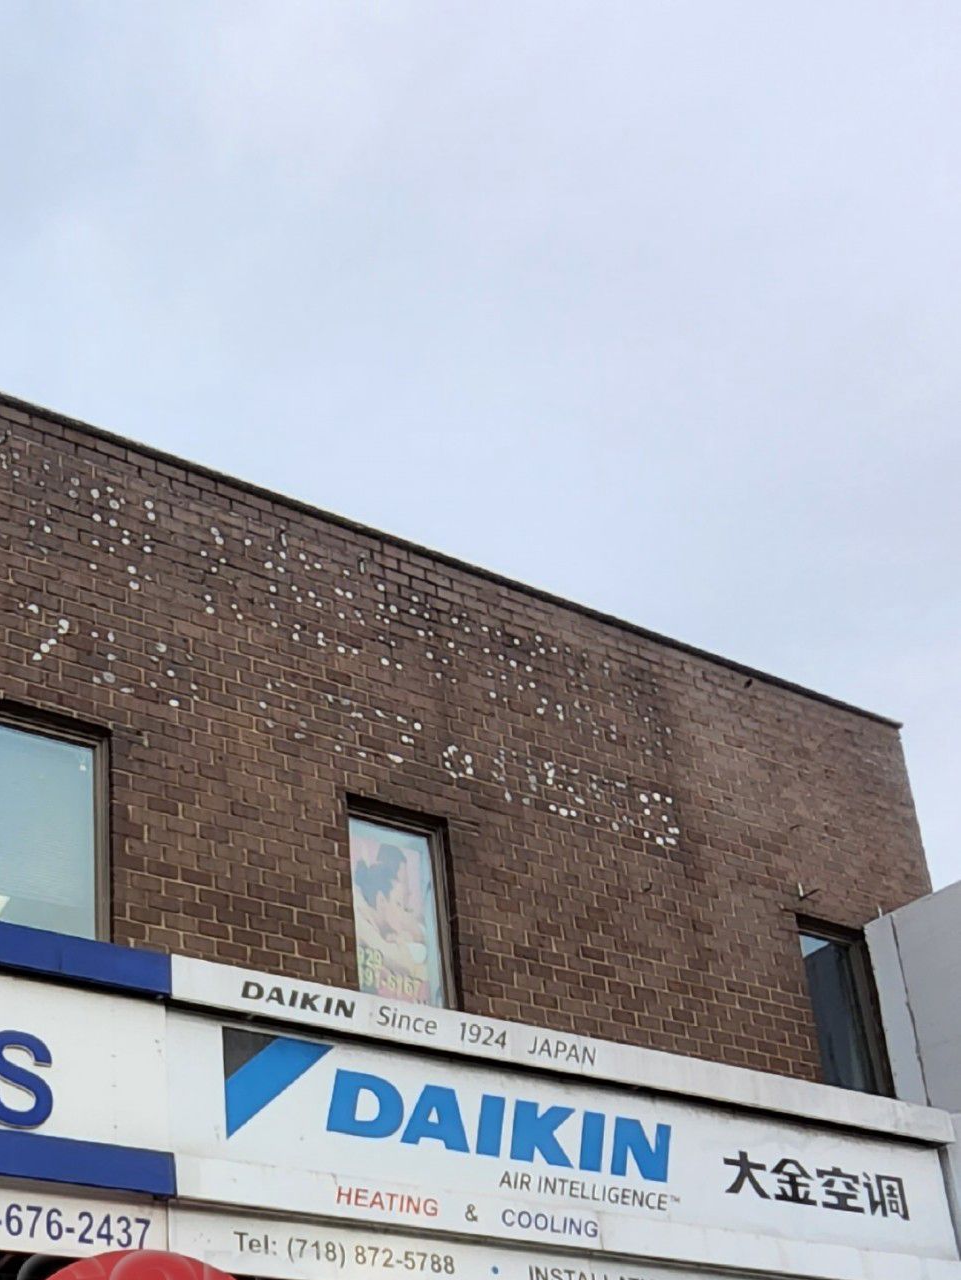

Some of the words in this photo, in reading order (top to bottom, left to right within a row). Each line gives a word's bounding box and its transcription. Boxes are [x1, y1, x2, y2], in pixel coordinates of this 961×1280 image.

[241, 981, 356, 1018] DAIKIN
[376, 1006, 438, 1036] Since
[459, 1022, 507, 1050] 1924
[528, 1035, 597, 1067] JAPAN
[326, 1068, 672, 1184] DAIKIN
[499, 1170, 531, 1192] AIR
[723, 1150, 910, 1222] 大金空调
[337, 1186, 439, 1217] HEATING
[464, 1205, 478, 1222] &
[501, 1209, 599, 1239] COOLING
[234, 1231, 277, 1255] Tel:
[288, 1237, 346, 1268] (718)
[354, 1246, 455, 1275] 872-5788
